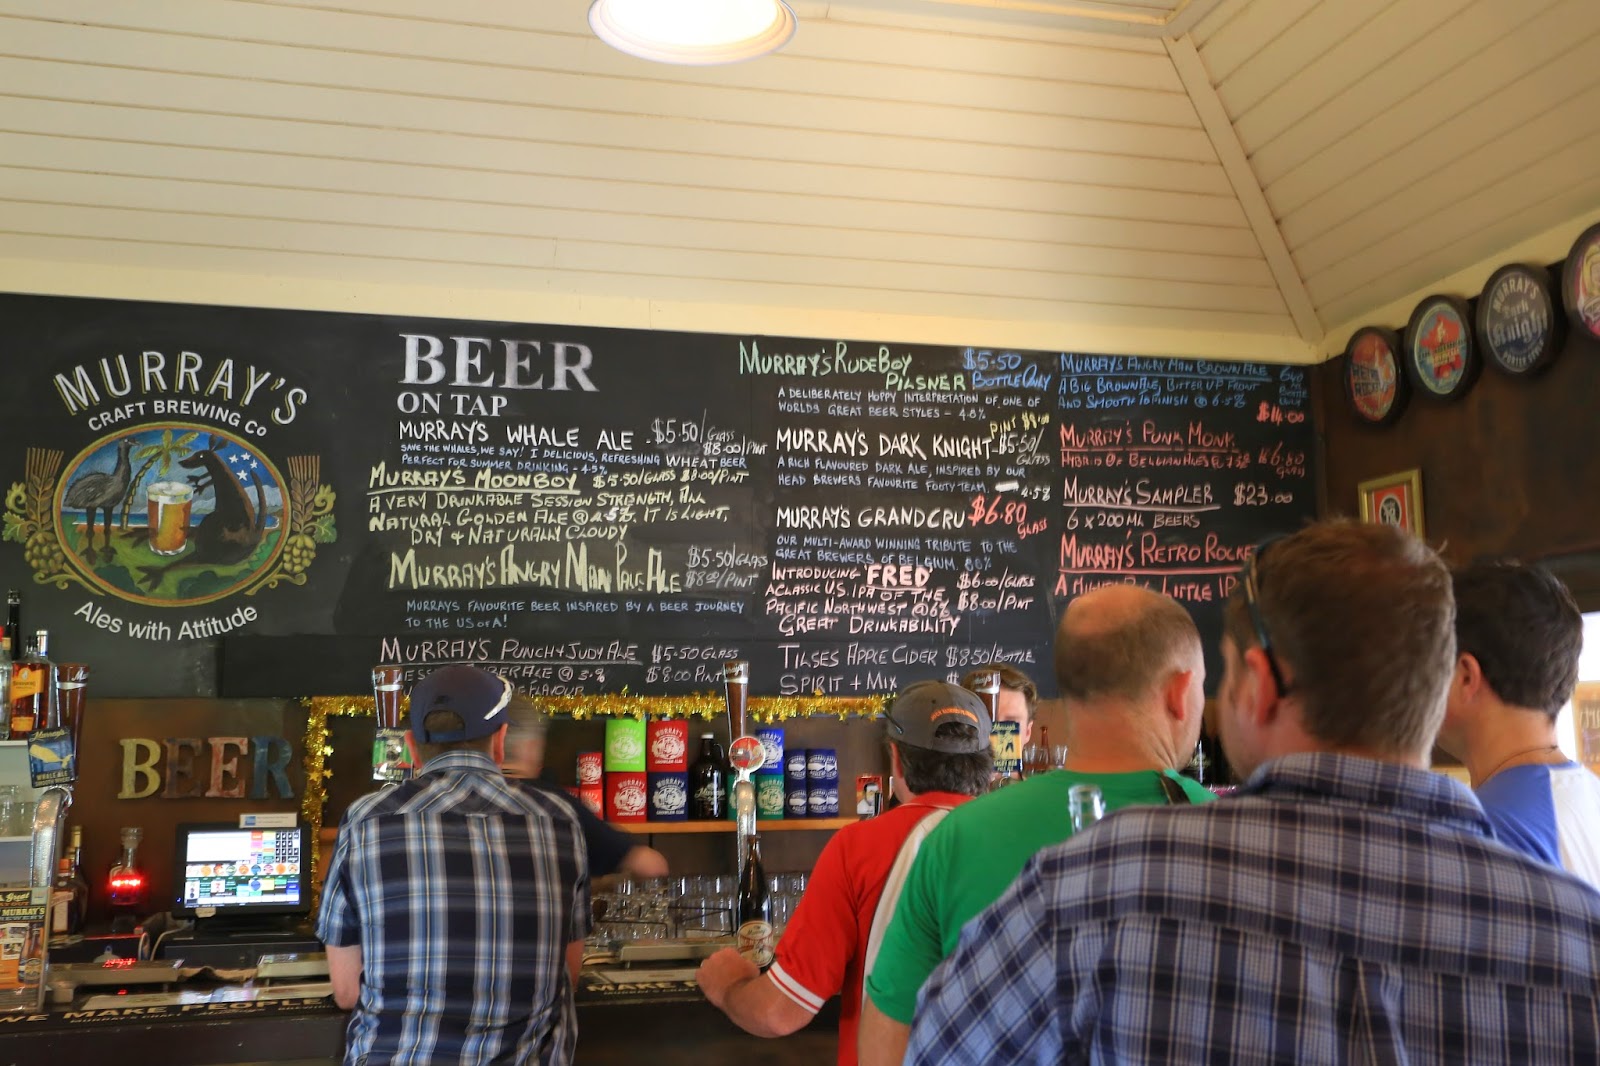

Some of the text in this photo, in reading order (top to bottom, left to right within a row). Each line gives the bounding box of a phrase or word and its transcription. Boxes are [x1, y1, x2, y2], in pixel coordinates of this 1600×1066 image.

[398, 333, 600, 392] BEER
[739, 340, 1022, 376] MURRAY'S $5.50
[54, 350, 307, 425] MURRAY'S
[885, 372, 966, 391] PILSNER
[397, 392, 508, 417] ON TAP
[777, 386, 1041, 407] A DELIBERATELY HOPPY INTERPRETATION OF ONE OF
[88, 402, 146, 432] CRAFT
[153, 400, 241, 427] BREWING
[778, 401, 940, 418] WORLDS GREAT BEER STYLES
[400, 420, 634, 451] MURRAY'S WHALE ALE
[776, 426, 992, 460] MURRAY'S DARK KNIGHT
[1060, 420, 1133, 448] MURRAY'S
[400, 444, 747, 468] SAVE THE SAY! DELICIOUS, REFRESHING WHEAT BEER
[401, 454, 569, 474] PERFECT FOR SUMMER DRINKING
[777, 455, 1025, 478] A RICH FLAVOURED DARK INSPIRED BY OUR
[369, 460, 466, 489] MURRAY'S
[778, 472, 955, 492] HEAD BREWERS FAVOURITE FOOTY
[369, 491, 674, 513] A VERY DRINKABLE SESSION STRENGTH,
[1064, 474, 1293, 506] MURRAY'S SAMPLER $23.00
[369, 507, 678, 532] NATURAL GOLDEN ALE IT IS
[776, 494, 1028, 530] MURRAY'S $6.80
[1066, 507, 1200, 530] 6 BEERS
[411, 524, 628, 548] DRY NATURALLY CLOUDY
[1017, 516, 1048, 540] GLASS
[777, 534, 1018, 553] OUR MULTI-AWARD WINNING TRIBUTE TO THE
[1060, 529, 1200, 570] MURRAY'S RETRO
[389, 541, 682, 594] MURRAY'S ANGRY MAN ALE
[775, 548, 895, 565] GREAT BREWERS OF
[772, 561, 861, 580] INTRODUCING
[880, 588, 945, 604] OF THE
[1054, 573, 1067, 597] A
[467, 601, 744, 614] FAVOURITE BEER INSPIRED BY A BEER JOURNEY
[765, 596, 907, 615] PACIFIC NORTHWEST
[74, 601, 258, 641] Ales with Attitude
[405, 617, 475, 629] TO THE US
[778, 614, 961, 637] GREAT DRINKABILITY
[380, 636, 491, 663] MURRAY'S
[607, 640, 638, 661] ALE
[701, 645, 739, 660] GLASS
[847, 641, 889, 665] APPLE
[892, 644, 937, 666] CIDER
[780, 671, 898, 695] SPIRIT MIX
[117, 736, 295, 799] BEER
[63, 1007, 168, 1019] MAKE
[182, 998, 323, 1012] PEOPLE
